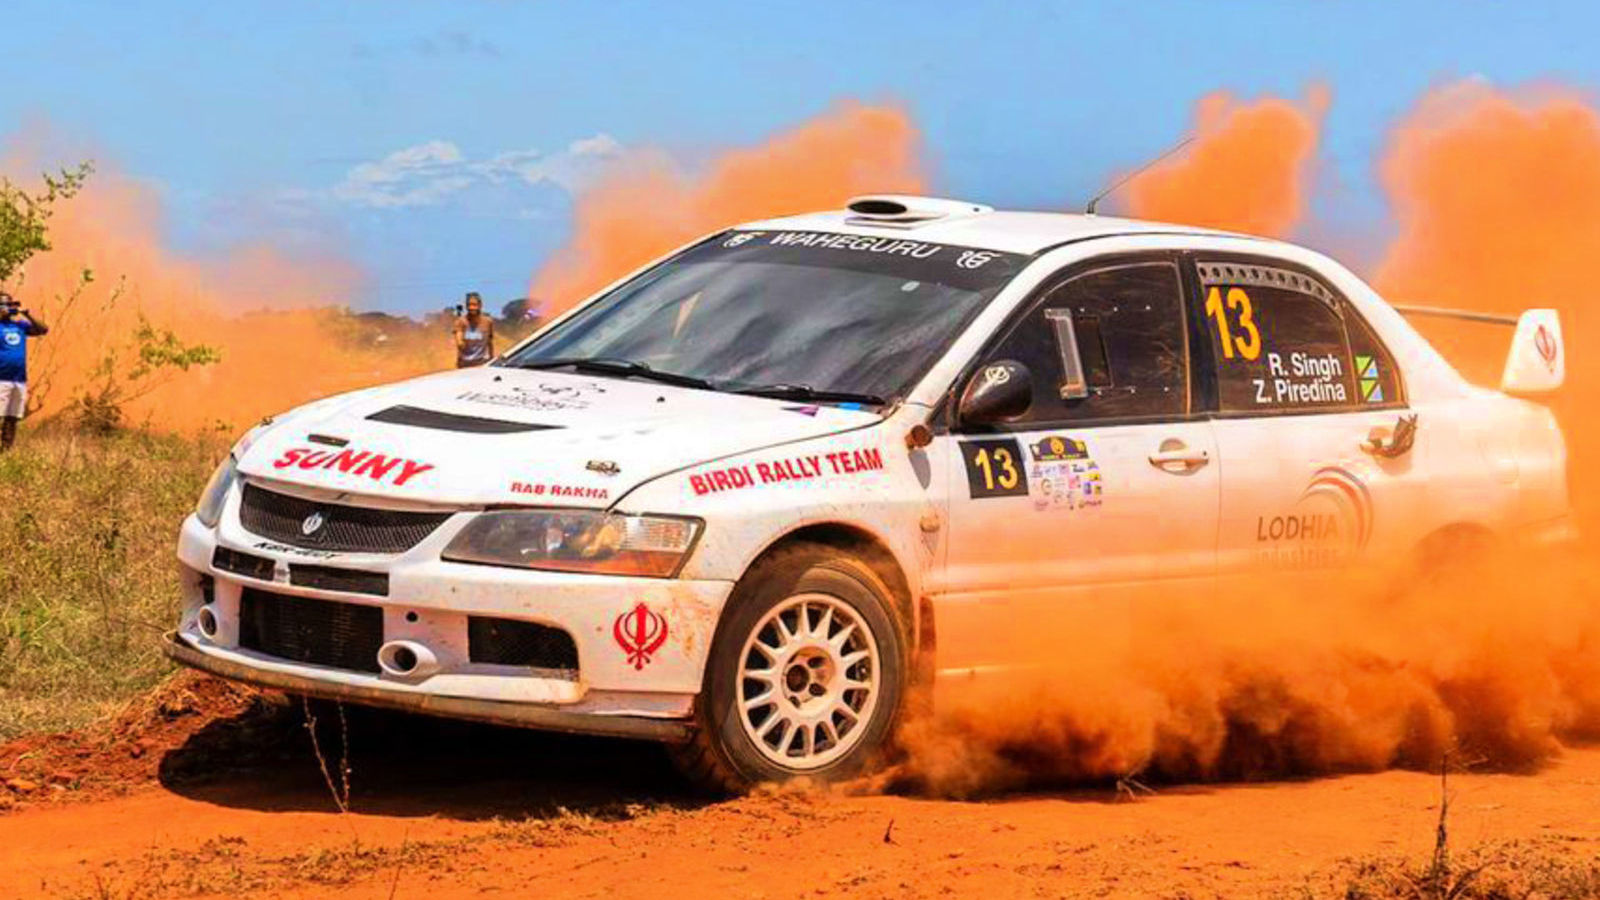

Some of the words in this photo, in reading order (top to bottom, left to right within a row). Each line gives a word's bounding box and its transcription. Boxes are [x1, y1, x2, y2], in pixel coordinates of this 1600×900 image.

[769, 231, 942, 258] WAHEGURU
[1205, 286, 1261, 361] 13
[1268, 353, 1289, 376] R.
[1291, 352, 1342, 381] Singh
[1253, 379, 1273, 403] Z.
[1275, 379, 1347, 403] Piredina
[272, 447, 434, 486] SUNNY
[689, 465, 755, 496] BIRDI
[756, 455, 823, 485] RALLY
[825, 448, 883, 474] TEAM
[974, 447, 1019, 490] 13
[511, 482, 545, 495] RAB
[550, 484, 608, 499] RAKHA
[1257, 514, 1339, 542] LODHIA
